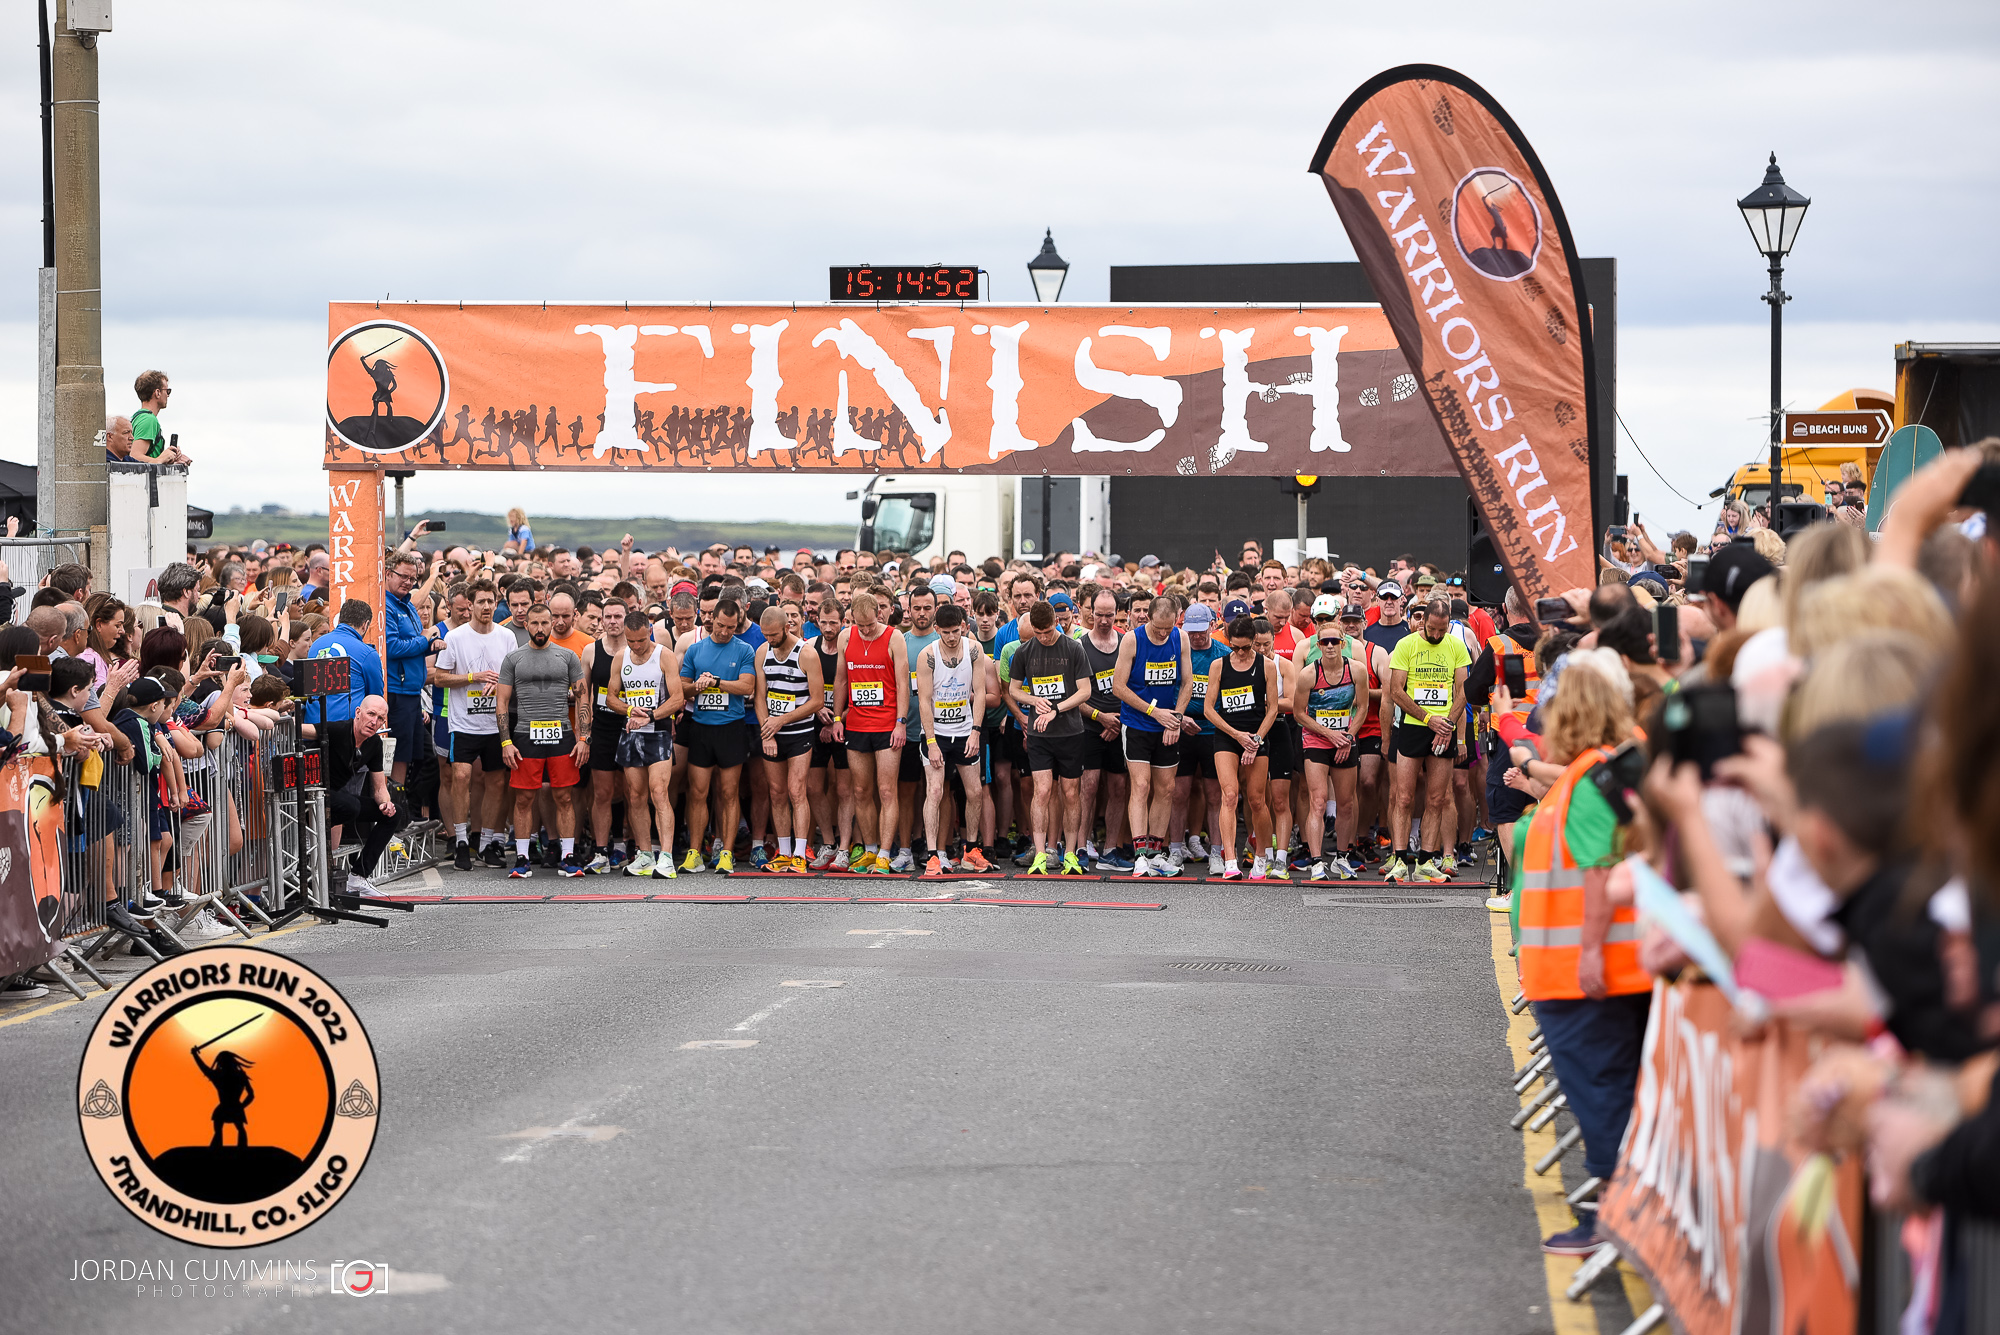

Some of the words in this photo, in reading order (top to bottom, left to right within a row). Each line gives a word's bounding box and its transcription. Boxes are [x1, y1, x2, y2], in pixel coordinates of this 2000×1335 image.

[846, 269, 974, 297] 15:14:52
[1355, 120, 1515, 431] WARRIORS
[1494, 433, 1578, 562] RUN
[574, 317, 1352, 463] FINISH
[1809, 424, 1840, 434] BEACH
[1843, 424, 1868, 434] BUNS
[1148, 668, 1174, 680] 1152
[644, 680, 657, 689] A.C.
[1037, 683, 1058, 695] 212
[702, 694, 723, 704] 788
[856, 689, 877, 700] 595
[1423, 689, 1439, 700] 78
[473, 697, 495, 708] 927
[770, 699, 790, 711] 887
[1226, 694, 1248, 707] 907
[940, 708, 962, 718] 402
[1321, 717, 1343, 728] 321
[532, 728, 560, 739] 1136
